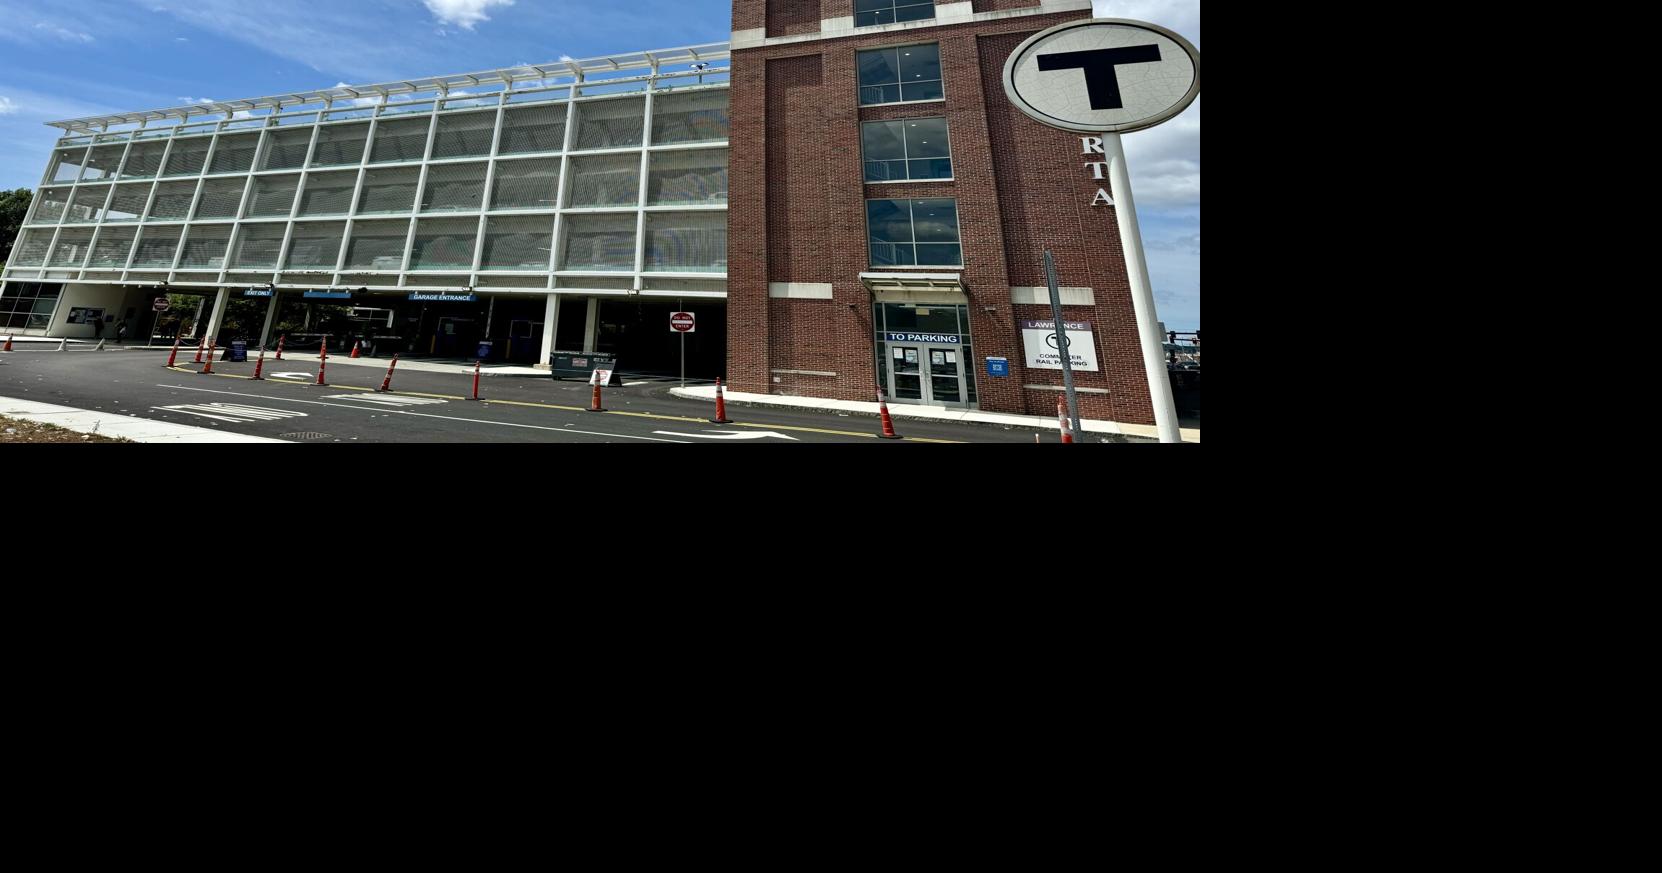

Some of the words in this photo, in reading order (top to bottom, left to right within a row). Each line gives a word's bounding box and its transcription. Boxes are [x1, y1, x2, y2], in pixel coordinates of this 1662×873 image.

[1036, 44, 1162, 110] T
[1028, 321, 1085, 330] LAWRNCE
[890, 333, 905, 341] TO
[907, 334, 957, 343] PARKING
